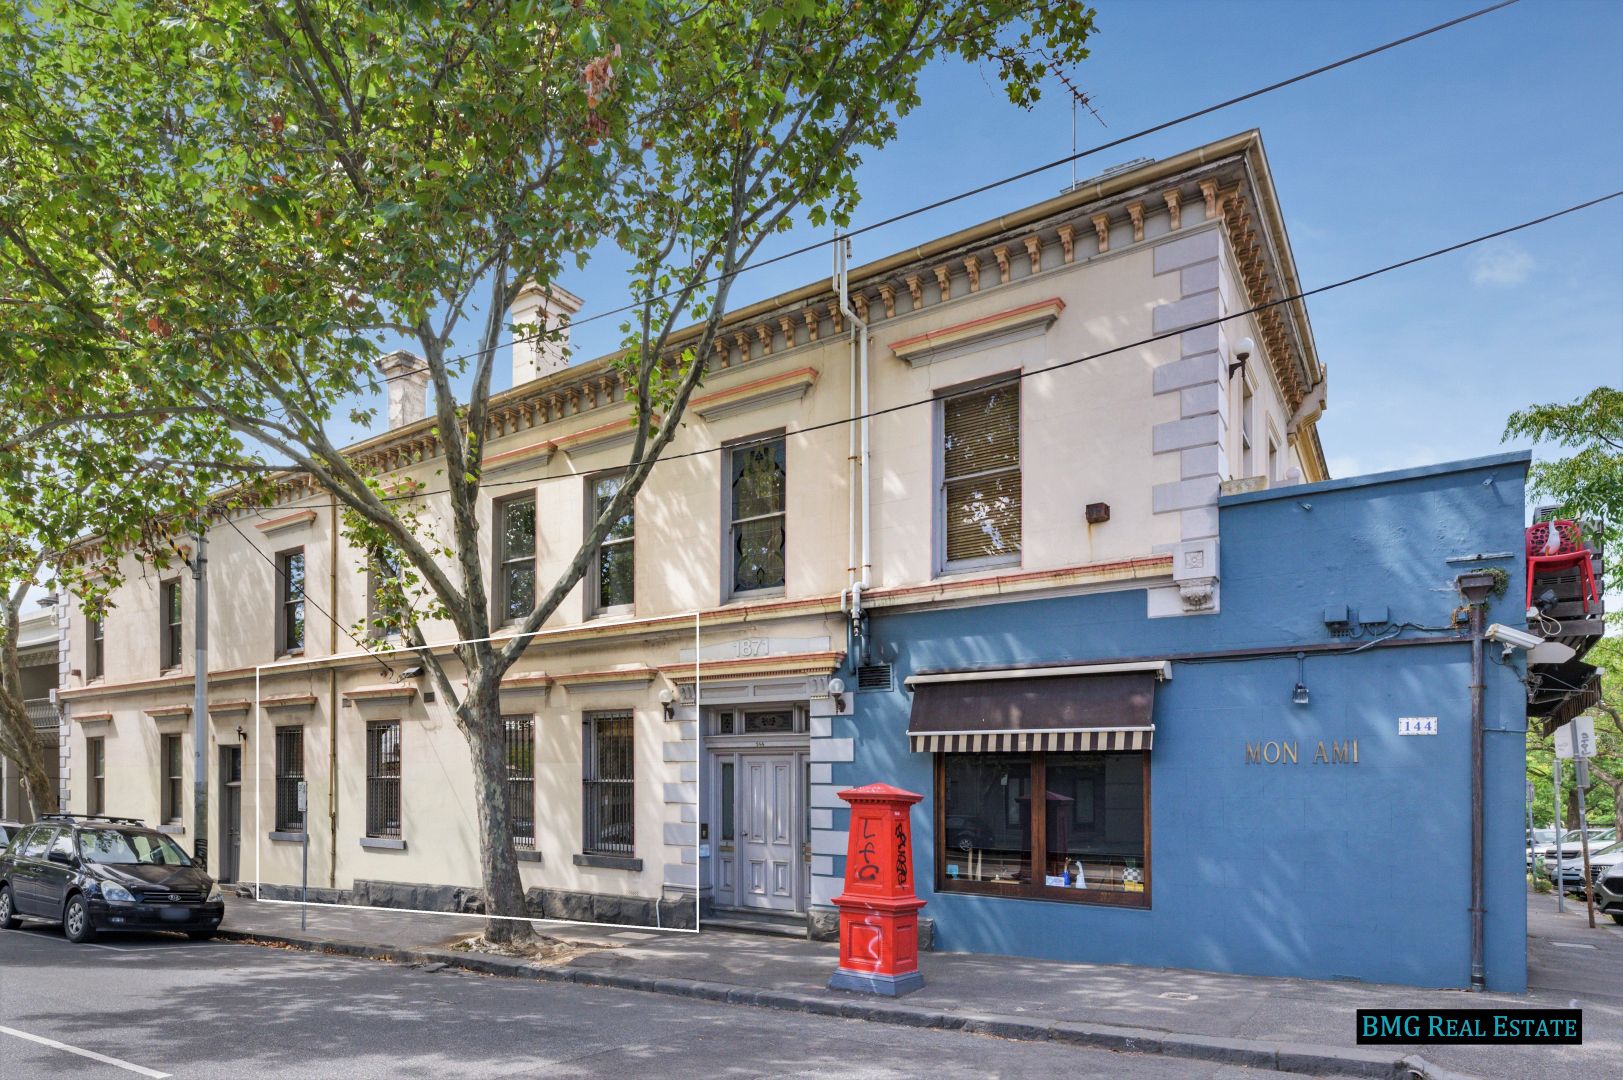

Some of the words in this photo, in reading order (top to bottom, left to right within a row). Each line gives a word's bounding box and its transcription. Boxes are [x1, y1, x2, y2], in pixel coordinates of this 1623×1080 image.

[733, 638, 769, 658] 1871
[1404, 720, 1432, 732] 144
[1245, 740, 1299, 764] MON
[1312, 738, 1359, 764] AMI
